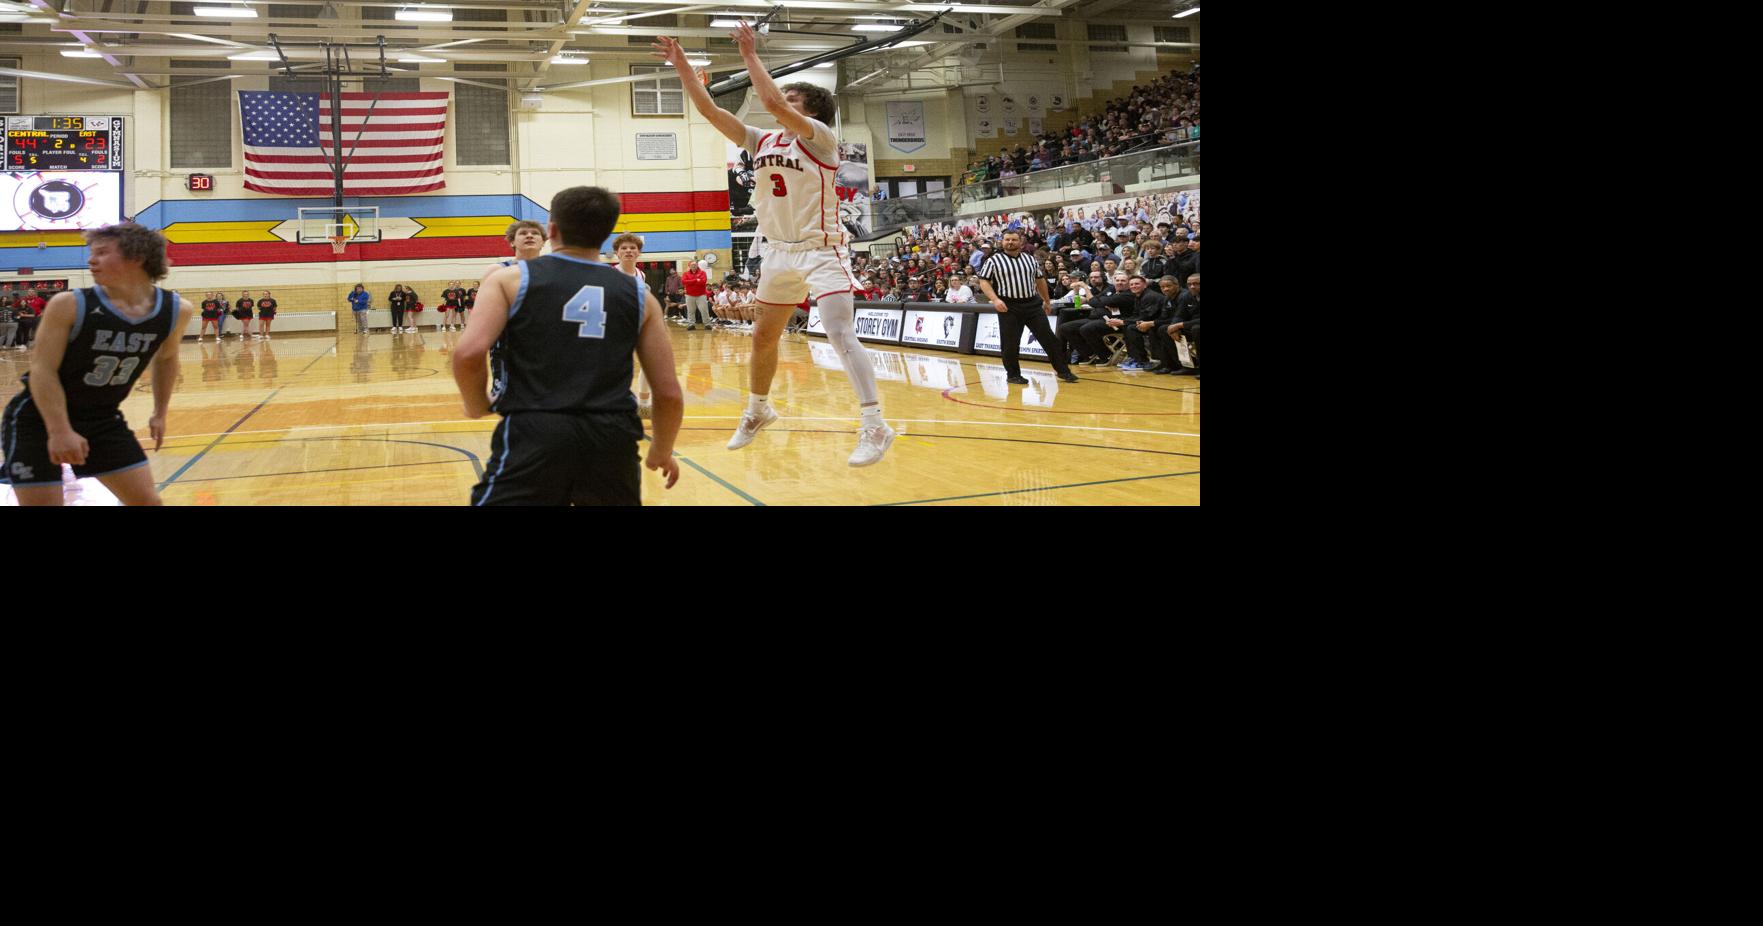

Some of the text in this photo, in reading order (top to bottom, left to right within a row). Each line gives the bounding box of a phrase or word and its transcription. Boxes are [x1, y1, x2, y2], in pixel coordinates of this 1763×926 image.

[52, 117, 82, 129] 1:35
[15, 138, 37, 149] 44
[54, 138, 63, 149] 2
[85, 138, 106, 150] 23
[112, 120, 121, 167] GYMNASIUM
[14, 154, 23, 165] 5
[96, 154, 106, 165] 2
[191, 177, 210, 189] 30
[769, 173, 788, 197] 3
[562, 284, 607, 339] 4
[855, 317, 899, 338] STOREY GYM
[92, 330, 157, 353] EAST
[83, 355, 140, 387] 33
